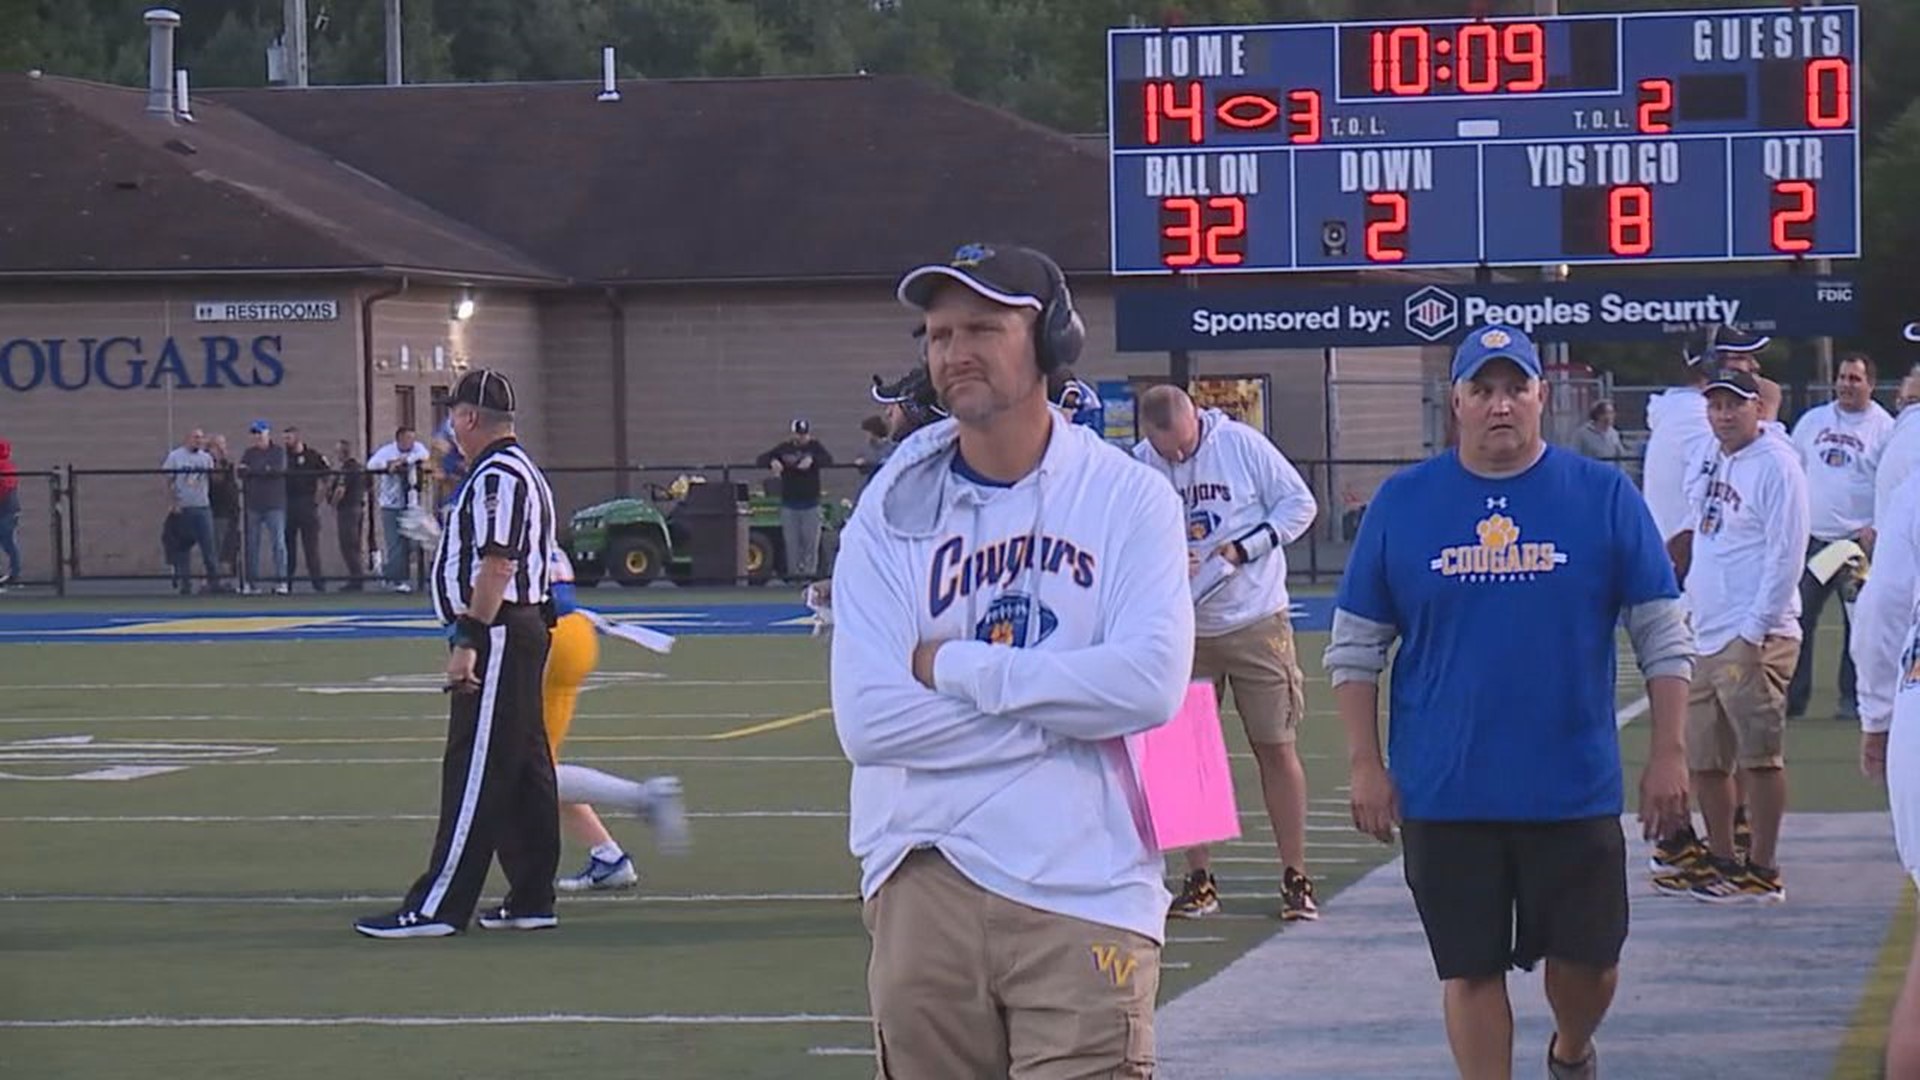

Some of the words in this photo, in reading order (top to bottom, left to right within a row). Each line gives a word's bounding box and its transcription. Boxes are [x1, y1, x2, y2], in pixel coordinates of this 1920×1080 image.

[1144, 34, 1246, 78] HOME
[1370, 22, 1546, 95] 10:09
[1693, 15, 1842, 61] GUESTS
[1144, 81, 1204, 145] 14
[1637, 78, 1673, 134] 2
[1805, 58, 1851, 128] 0
[1288, 89, 1321, 144] 3
[1146, 155, 1210, 197] BALL
[1219, 153, 1259, 194] ON
[1340, 149, 1432, 192] DOWN
[1526, 144, 1586, 187] YDS
[1594, 143, 1631, 185] TO
[1638, 141, 1680, 184] GO
[1763, 138, 1824, 180] QTR
[1162, 197, 1247, 266] 32
[1365, 192, 1408, 262] 2
[1608, 185, 1653, 255] 8
[1771, 181, 1816, 251] 2
[226, 303, 333, 320] RESTROOMS
[1465, 296, 1590, 333] Peoples
[1600, 292, 1740, 325] Security
[1817, 289, 1852, 301] FDIC
[1192, 305, 1340, 335] Sponsored
[1349, 305, 1391, 333] by:
[0, 336, 284, 392] OUGARS
[1181, 483, 1231, 509] gars
[929, 535, 1094, 618] Cougars
[1441, 543, 1556, 576] COUGARS
